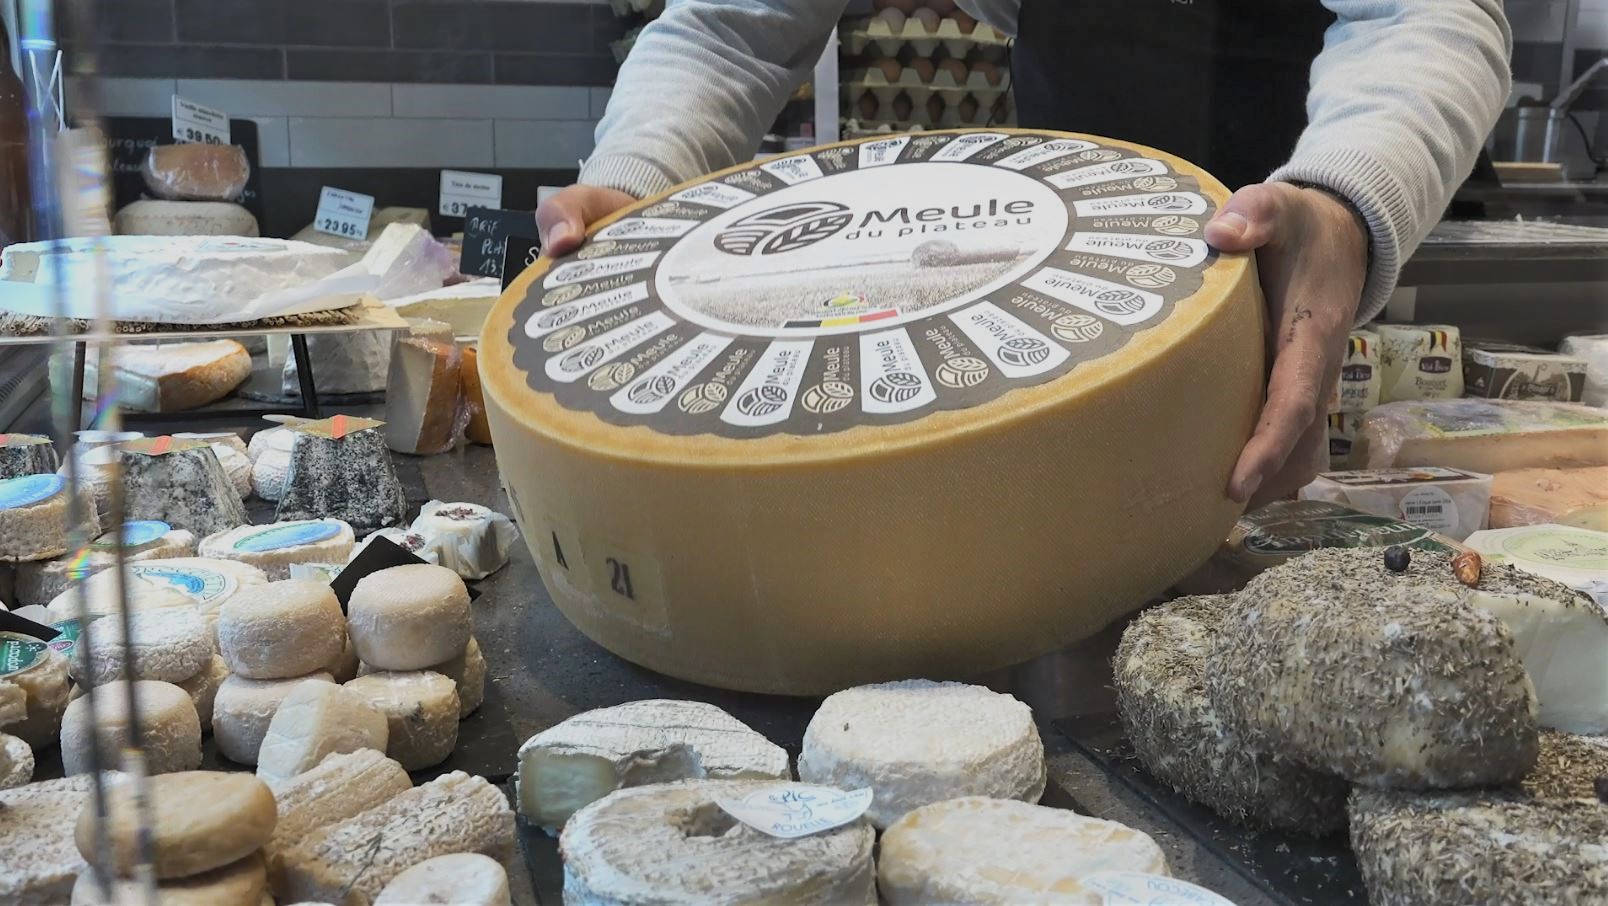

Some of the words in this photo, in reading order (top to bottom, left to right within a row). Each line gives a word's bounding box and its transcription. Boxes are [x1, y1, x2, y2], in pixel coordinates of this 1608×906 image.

[1082, 183, 1133, 196] Meule
[859, 198, 1034, 229] Meule
[1092, 200, 1147, 211] Meule
[845, 226, 882, 241] du
[898, 216, 1032, 238] plateau
[1093, 220, 1149, 228] Meule
[1086, 239, 1146, 250] Meule
[597, 257, 644, 271] Meule
[1069, 258, 1128, 274] Meule
[583, 273, 634, 292] Meule
[1045, 278, 1100, 297] Meule
[581, 290, 632, 313] Meule
[1011, 295, 1059, 321] Meule
[588, 306, 640, 333] Meule
[971, 314, 1012, 341] Meule
[604, 320, 653, 349] Meule
[925, 328, 961, 359] Meule
[630, 333, 678, 365] Meule
[667, 344, 709, 376] Meule
[876, 340, 900, 373] Meule
[712, 348, 747, 383] Meule
[765, 350, 792, 384] Meule
[823, 346, 840, 382] Meule
[606, 557, 634, 600] 21
